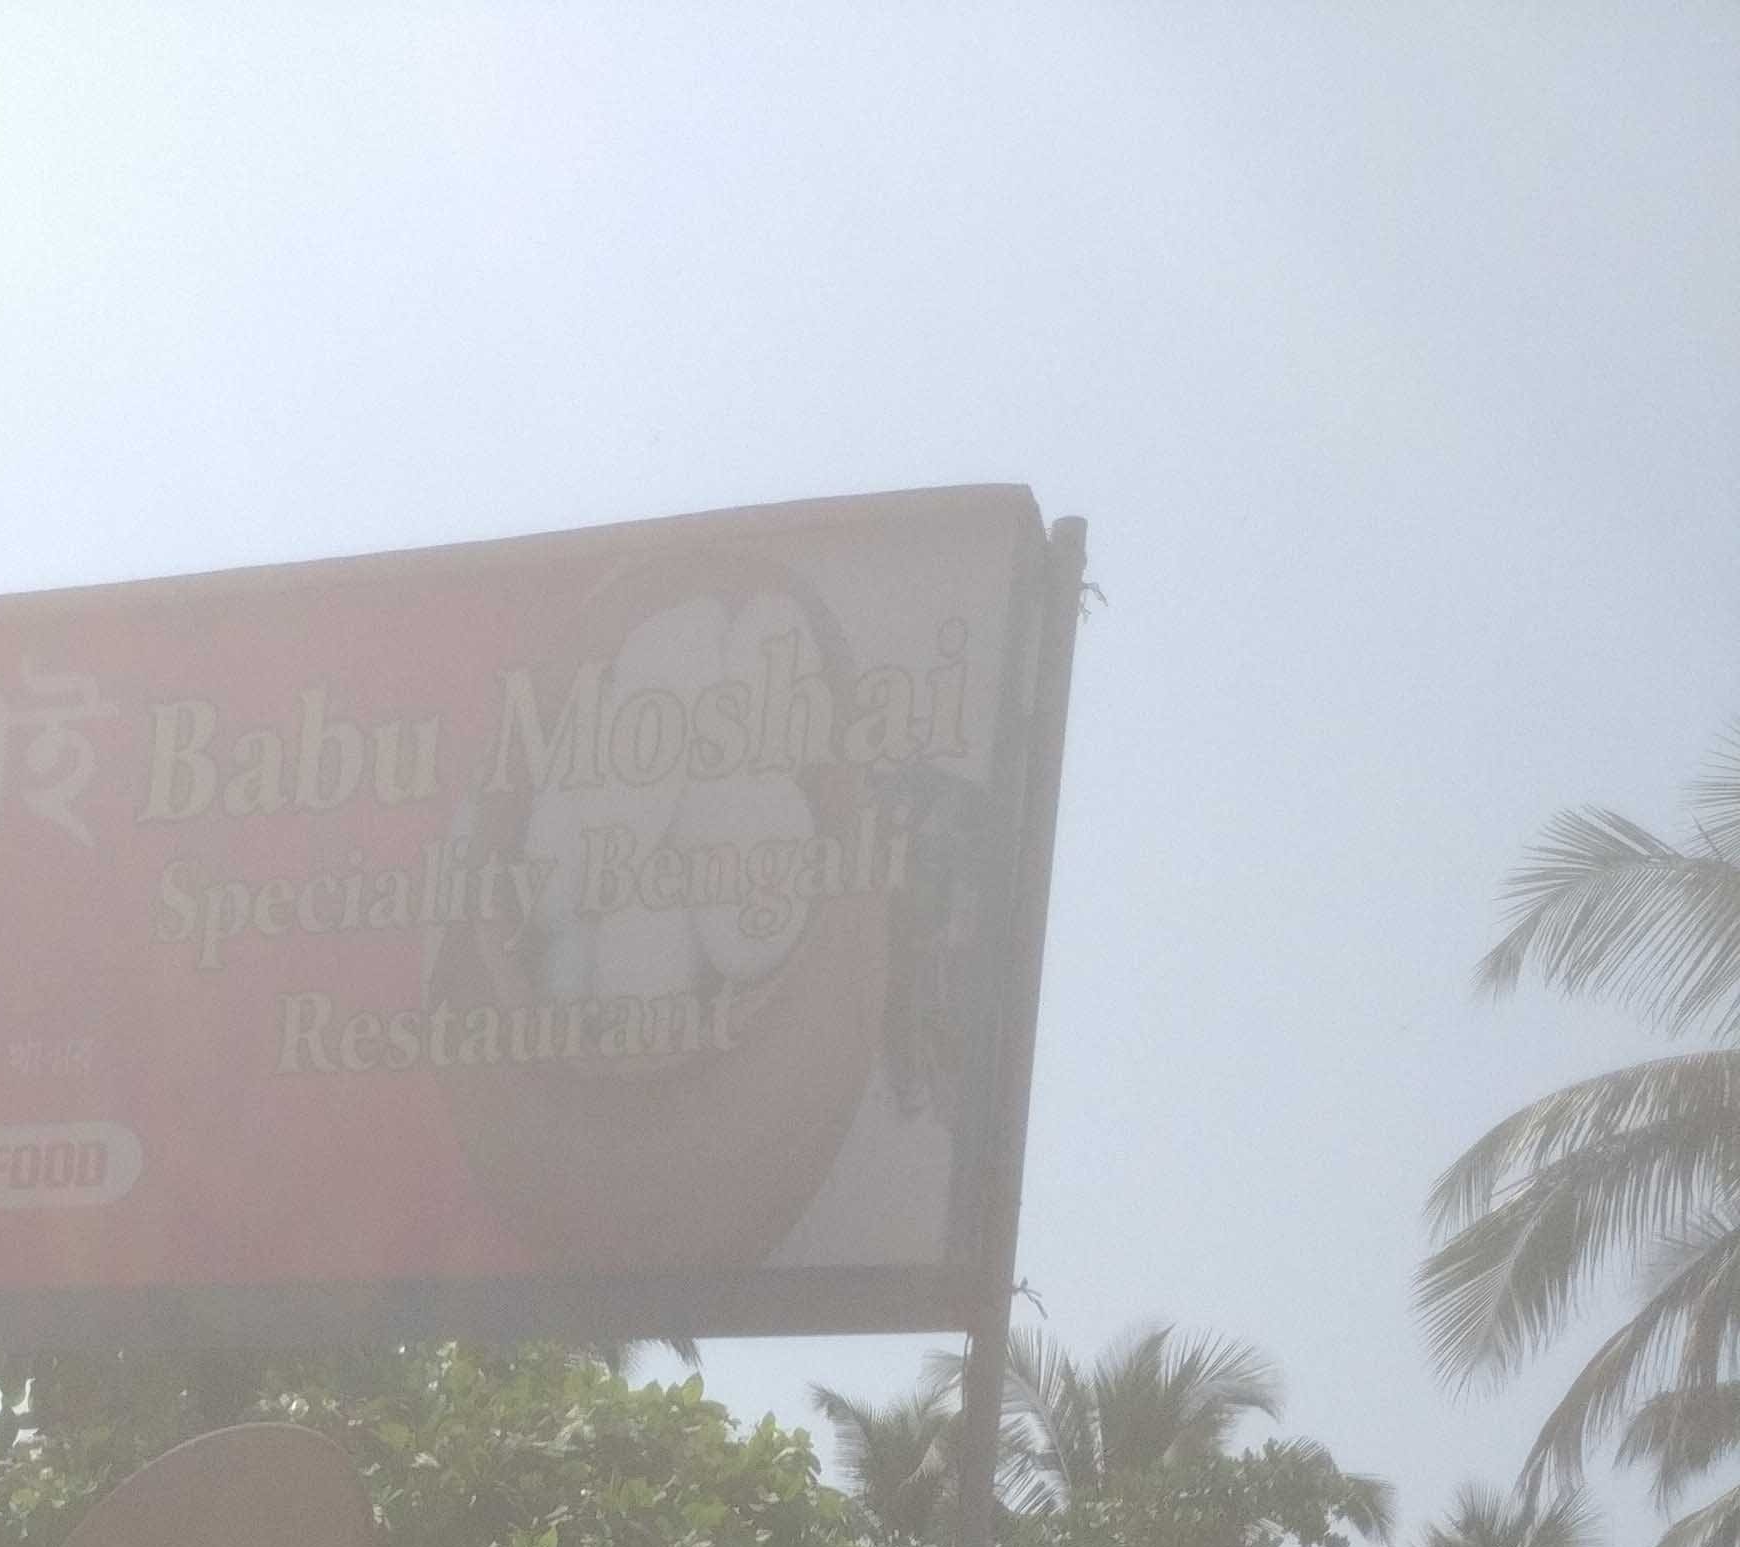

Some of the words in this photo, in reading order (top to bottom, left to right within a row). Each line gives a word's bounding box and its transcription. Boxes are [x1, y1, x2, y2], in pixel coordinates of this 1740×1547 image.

[136, 684, 446, 828] Babu
[479, 615, 970, 797] Moshai
[151, 838, 557, 971] Speciality
[577, 799, 916, 941] Bengali
[274, 988, 744, 1076] Restaurant
